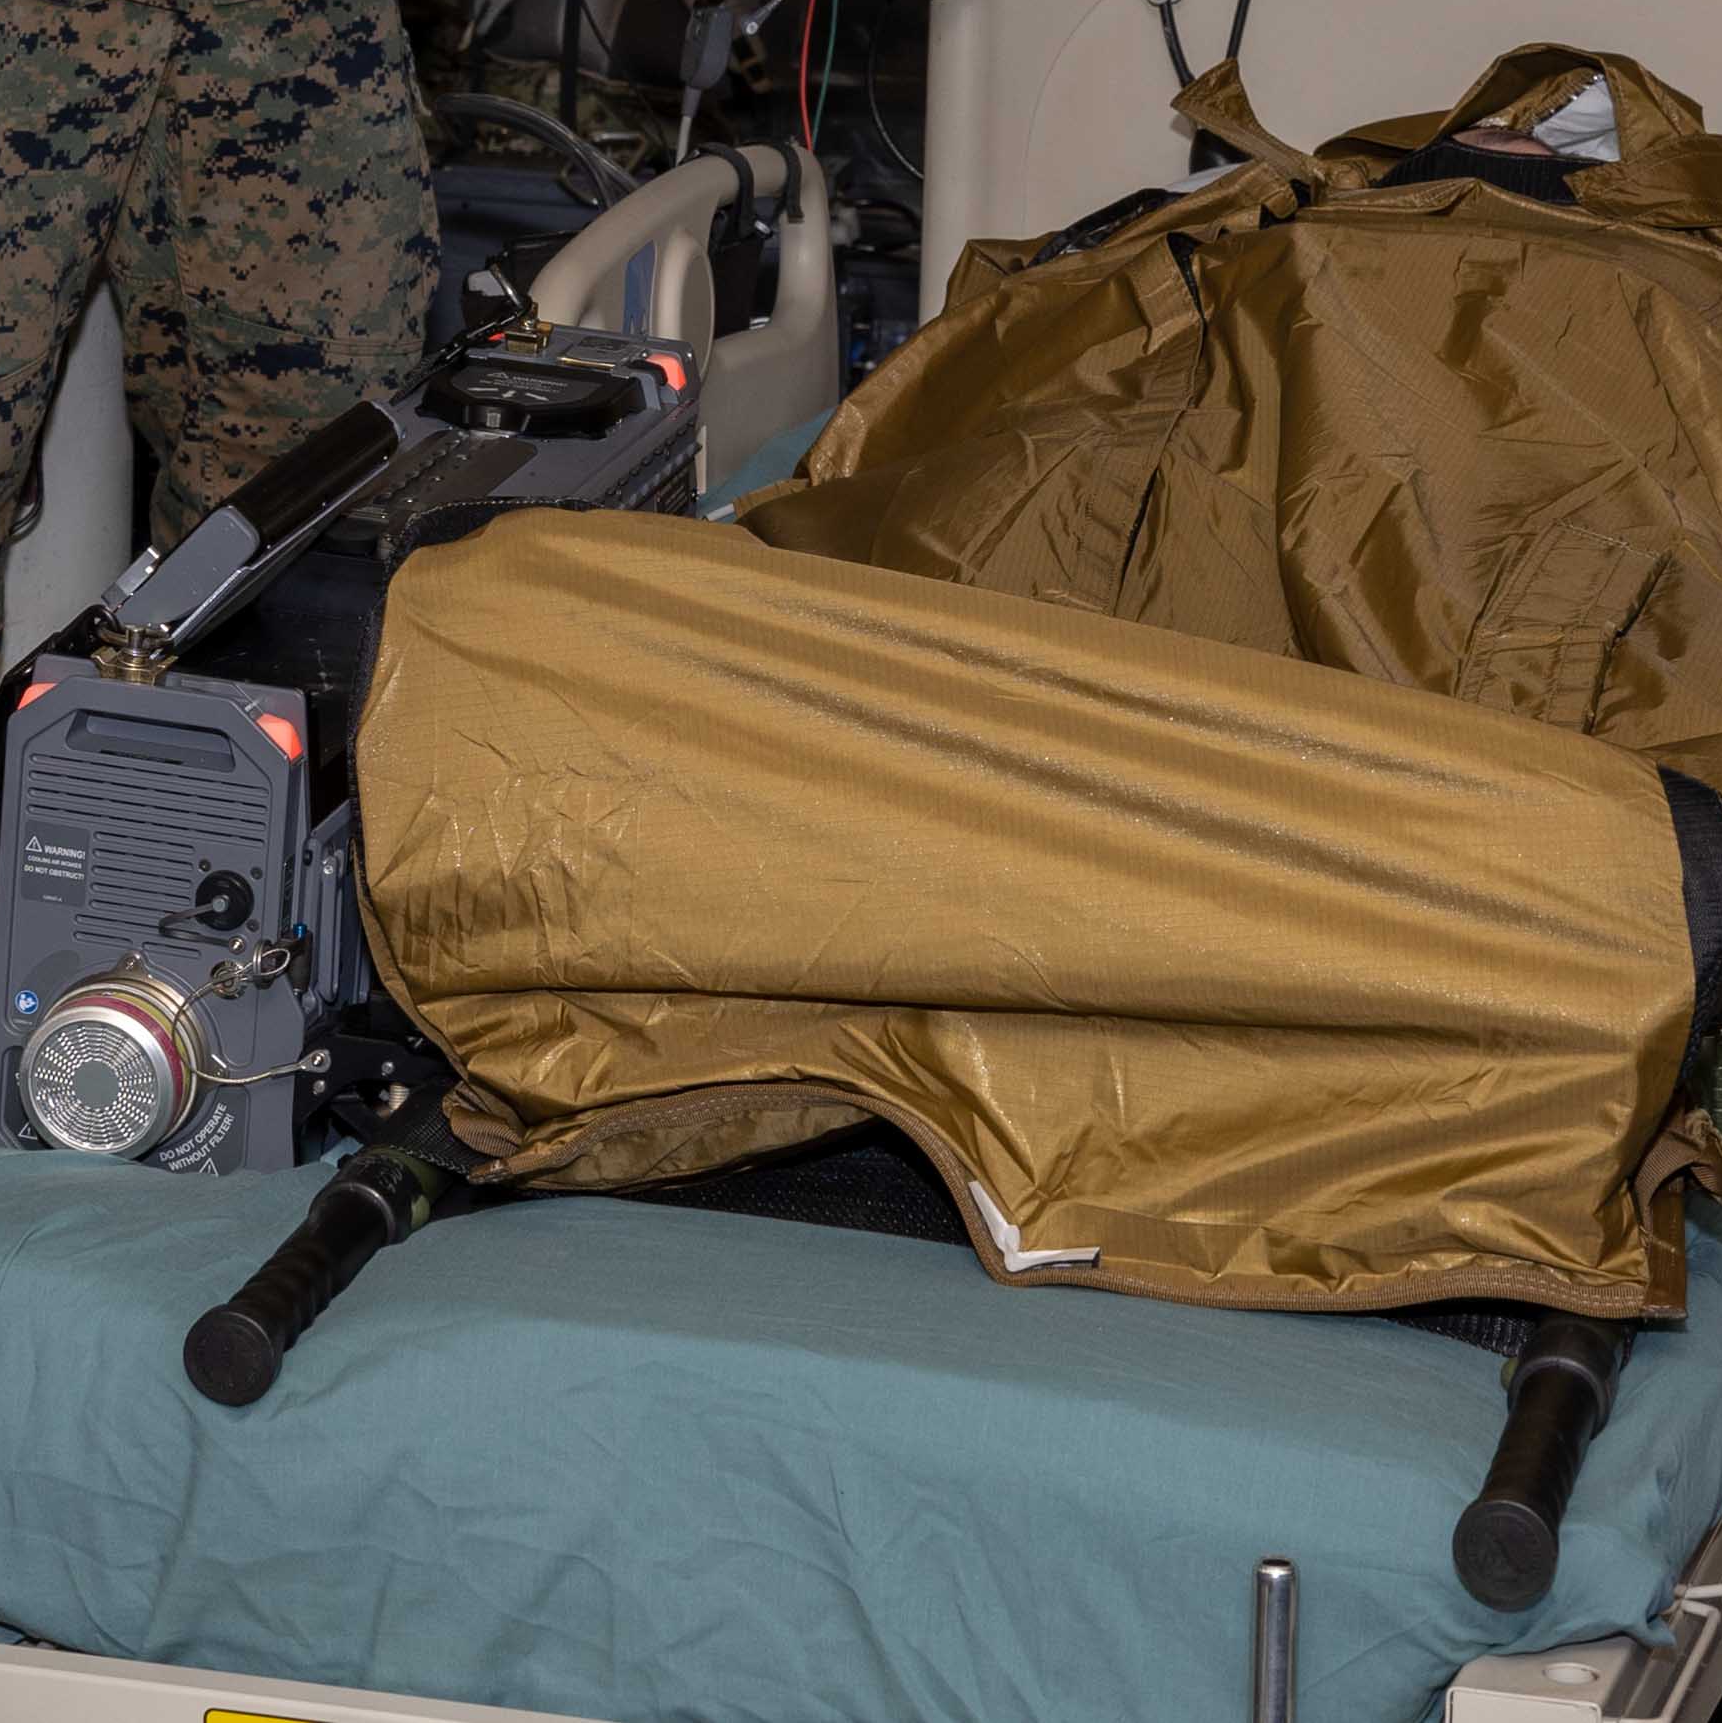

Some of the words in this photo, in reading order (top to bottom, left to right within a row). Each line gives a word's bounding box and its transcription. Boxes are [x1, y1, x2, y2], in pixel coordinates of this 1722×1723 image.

[23, 864, 34, 872] DO
[35, 866, 48, 874] NOT
[44, 845, 86, 860] WARNING!
[159, 1150, 175, 1162] DO
[175, 1139, 196, 1156] NOT
[194, 1102, 228, 1143] OPERATE
[168, 1145, 211, 1172] WITHOUT
[209, 1113, 235, 1148] FILTER!
